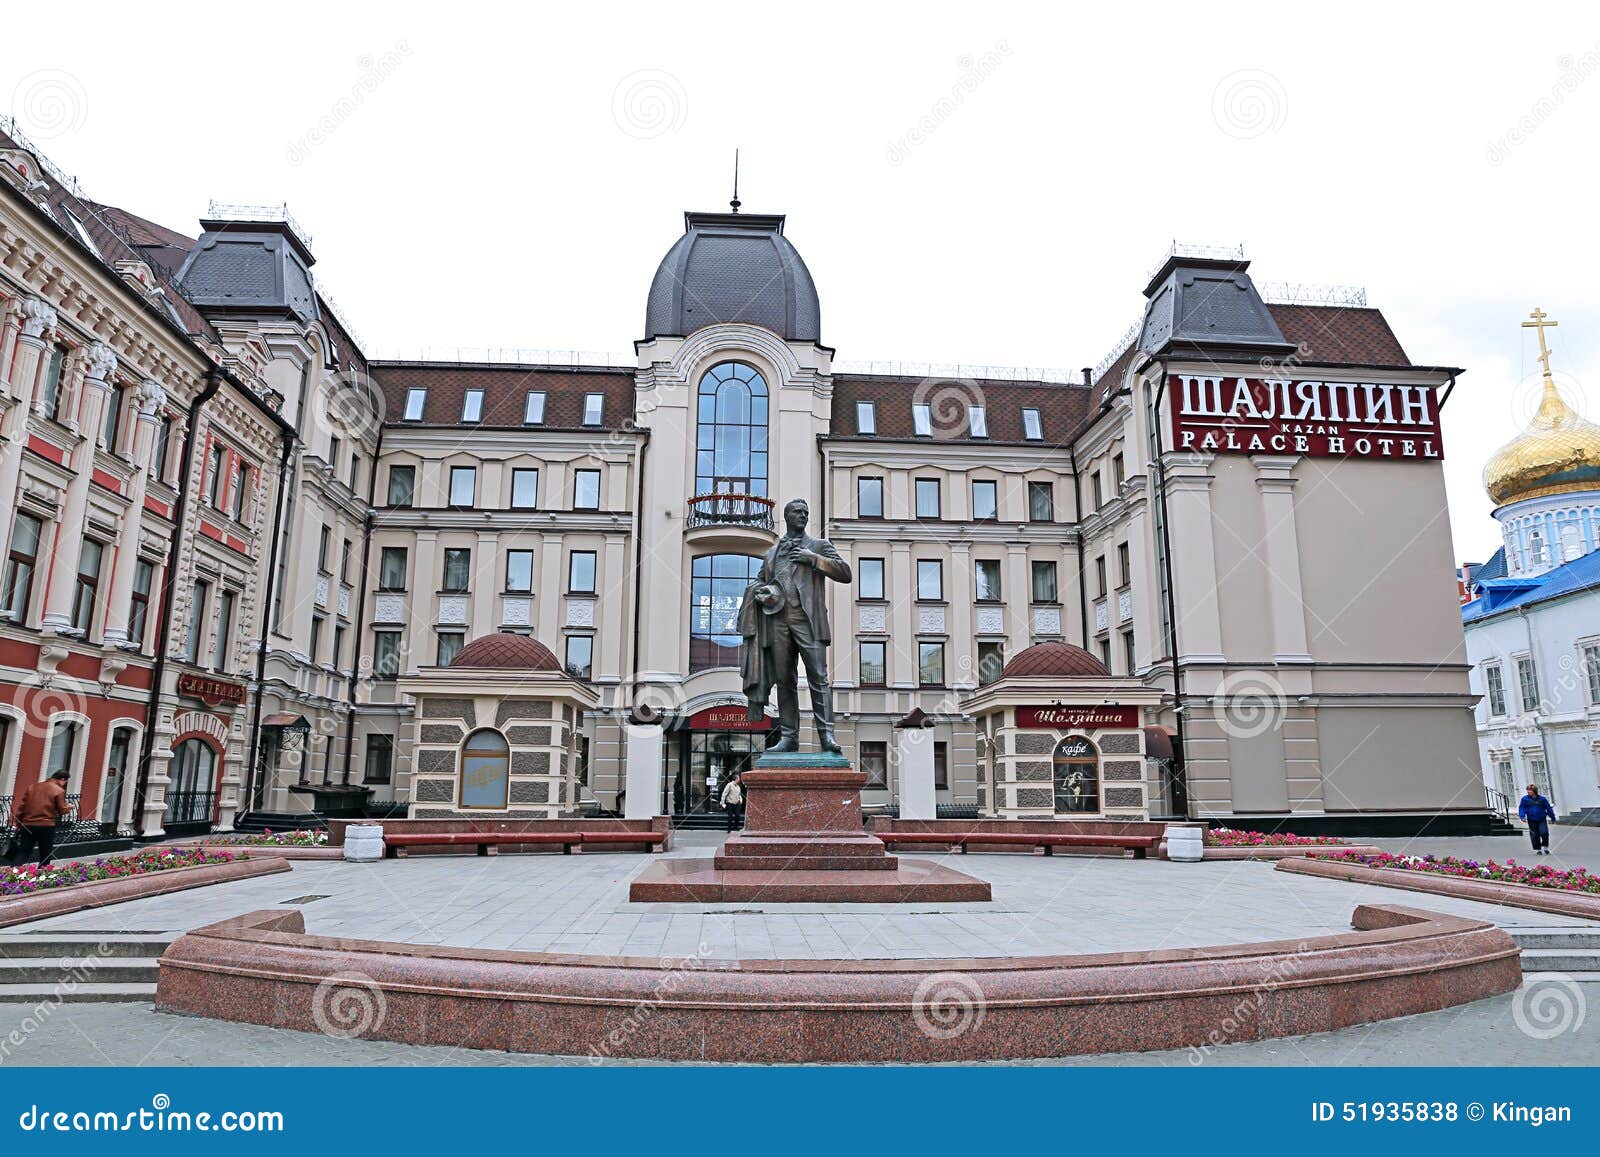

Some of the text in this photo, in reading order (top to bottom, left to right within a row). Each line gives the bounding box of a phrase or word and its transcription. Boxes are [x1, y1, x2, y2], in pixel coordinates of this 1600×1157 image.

[1178, 375, 1434, 425] ШАЛЯПИН
[1282, 424, 1339, 435] KAZAN
[1181, 431, 1438, 457] PALACE HOTEL
[709, 713, 749, 721] ШАЛЯПИ
